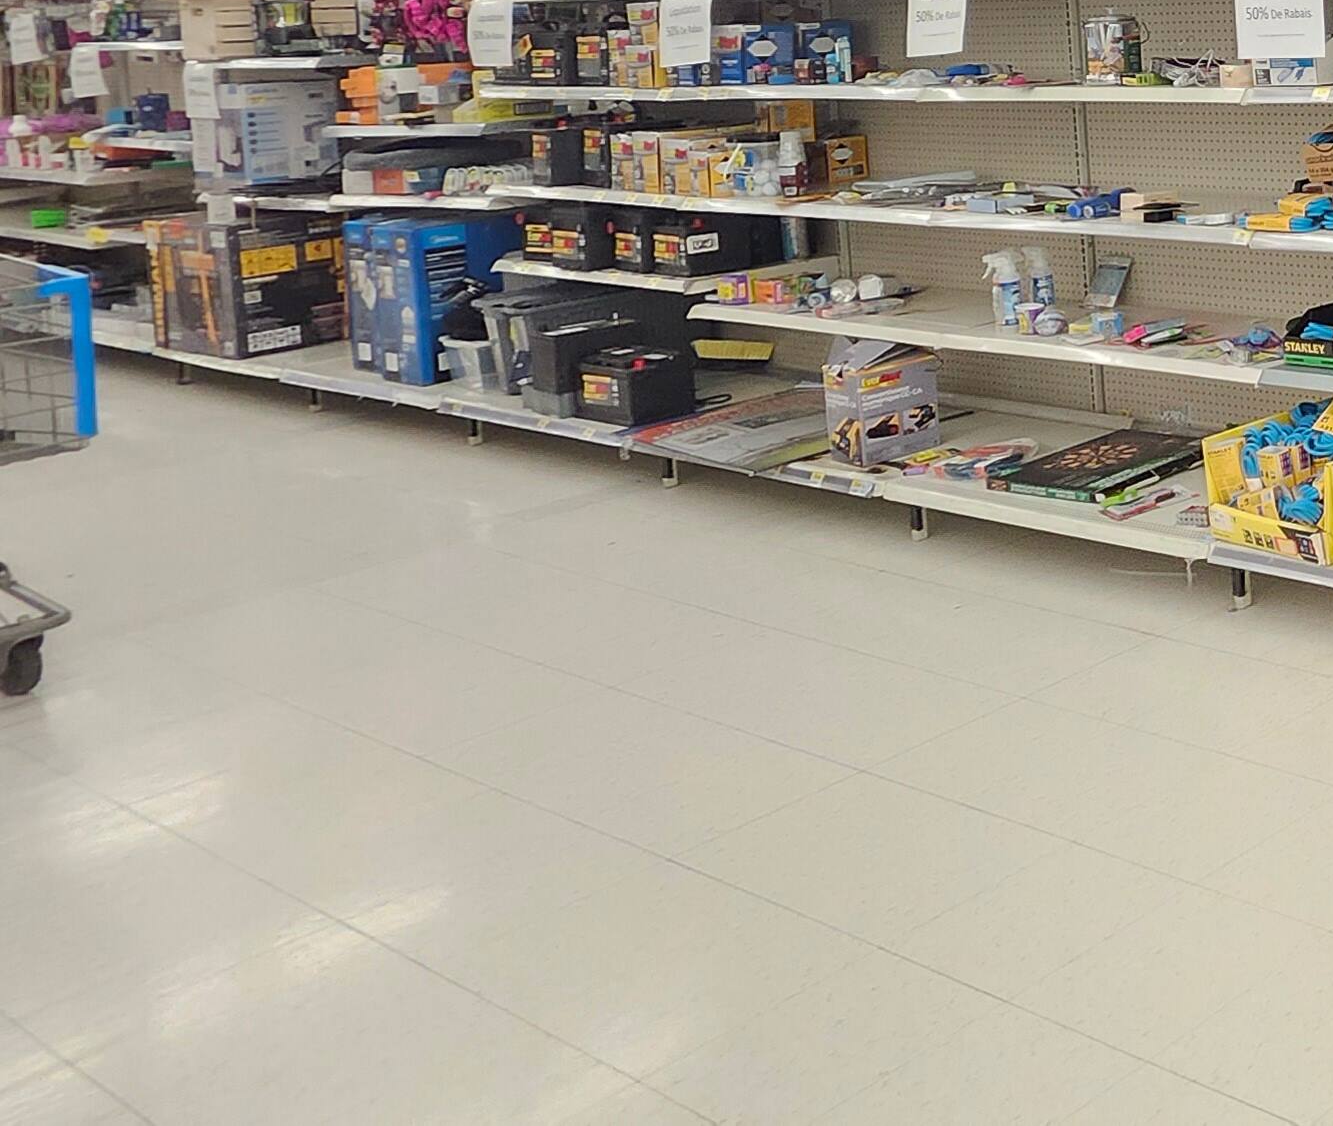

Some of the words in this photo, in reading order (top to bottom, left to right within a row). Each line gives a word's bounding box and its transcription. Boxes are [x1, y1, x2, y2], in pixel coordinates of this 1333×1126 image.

[915, 10, 934, 23] 50%
[1245, 7, 1270, 21] 50%
[1271, 10, 1283, 20] De
[1284, 8, 1312, 19] Rabais
[1284, 342, 1326, 355] STANLEY
